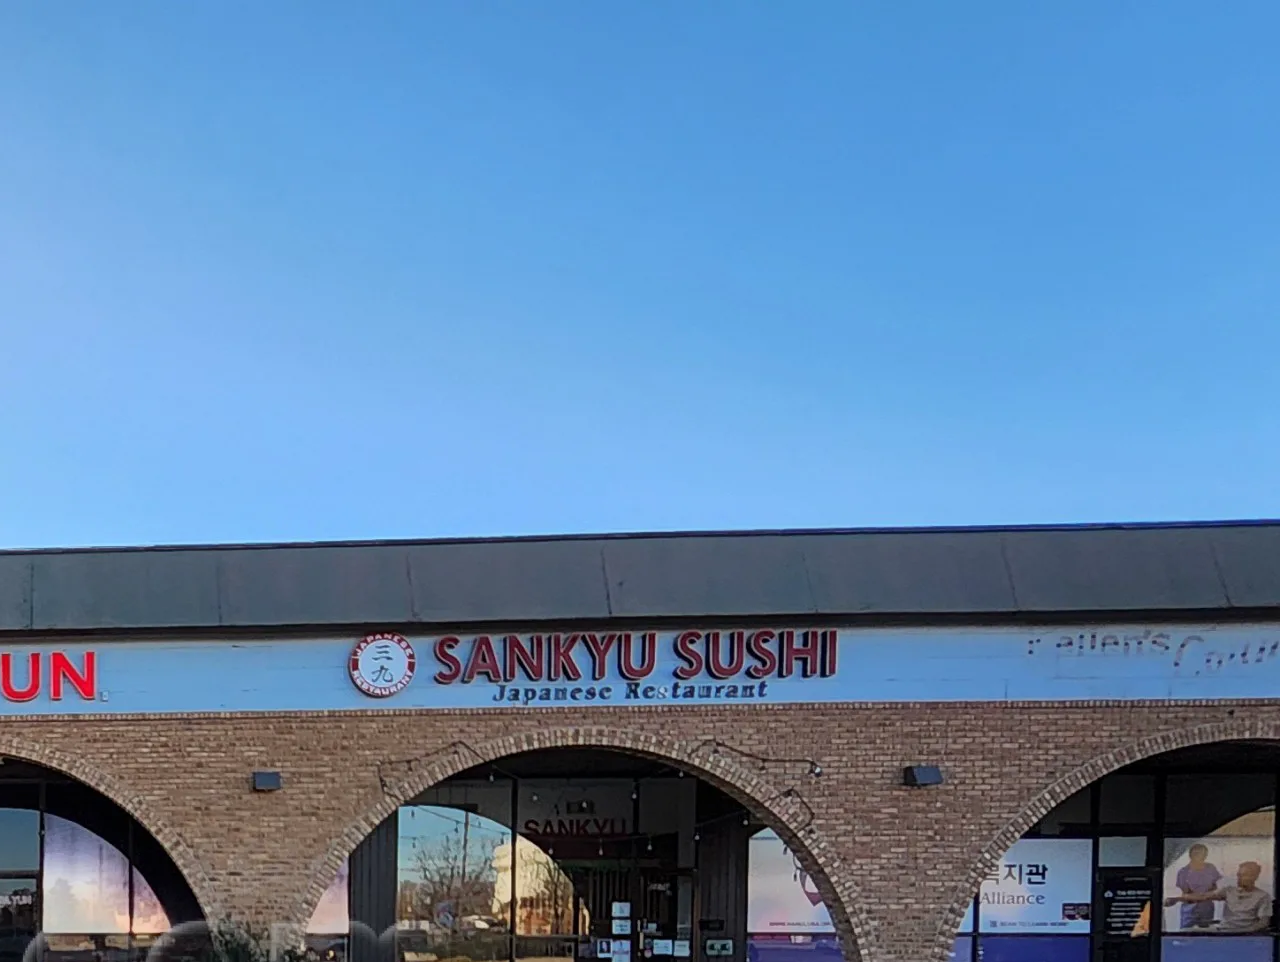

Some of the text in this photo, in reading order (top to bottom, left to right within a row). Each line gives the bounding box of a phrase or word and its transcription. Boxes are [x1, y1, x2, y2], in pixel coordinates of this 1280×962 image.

[355, 633, 413, 656] JAPANESE
[434, 629, 839, 684] SANKYU SUSHI
[371, 644, 394, 683] 三九
[352, 670, 413, 695] RESTAURANT
[492, 680, 768, 706] Japanese Restaurant
[523, 818, 628, 837] SANKYU
[979, 891, 1045, 905] Alliance
